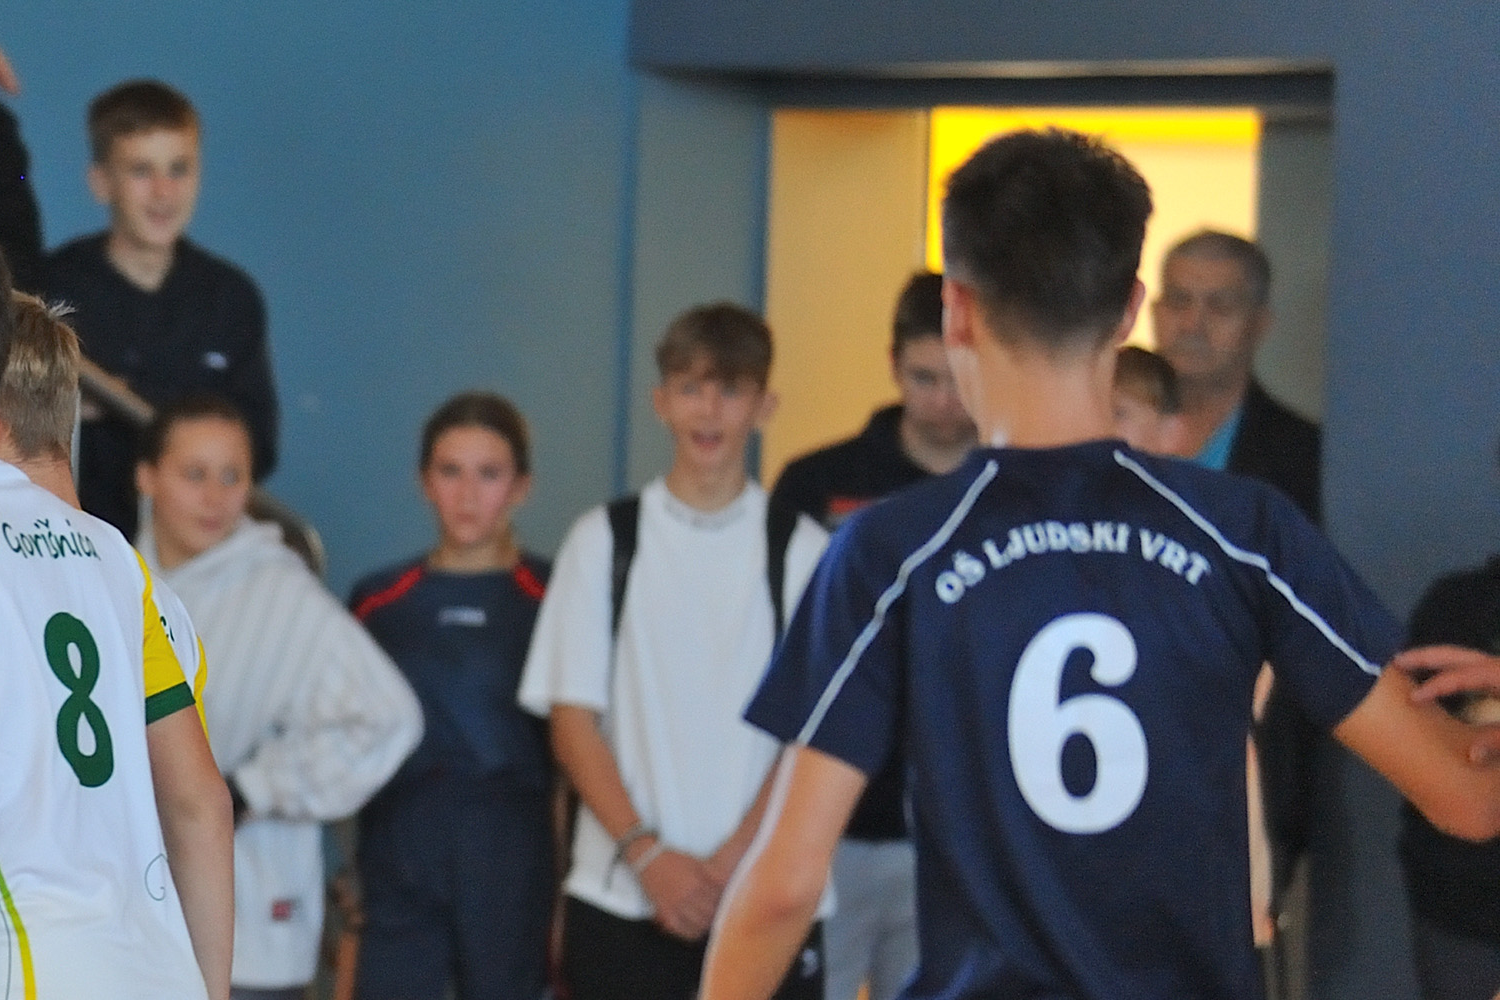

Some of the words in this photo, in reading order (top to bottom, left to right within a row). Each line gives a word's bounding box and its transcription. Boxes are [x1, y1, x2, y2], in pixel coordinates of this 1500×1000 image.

[934, 549, 986, 604] OŠ
[982, 520, 1131, 570] LJUDSKI
[1139, 528, 1211, 586] VRT
[44, 611, 114, 788] 8
[1007, 612, 1149, 835] 6
